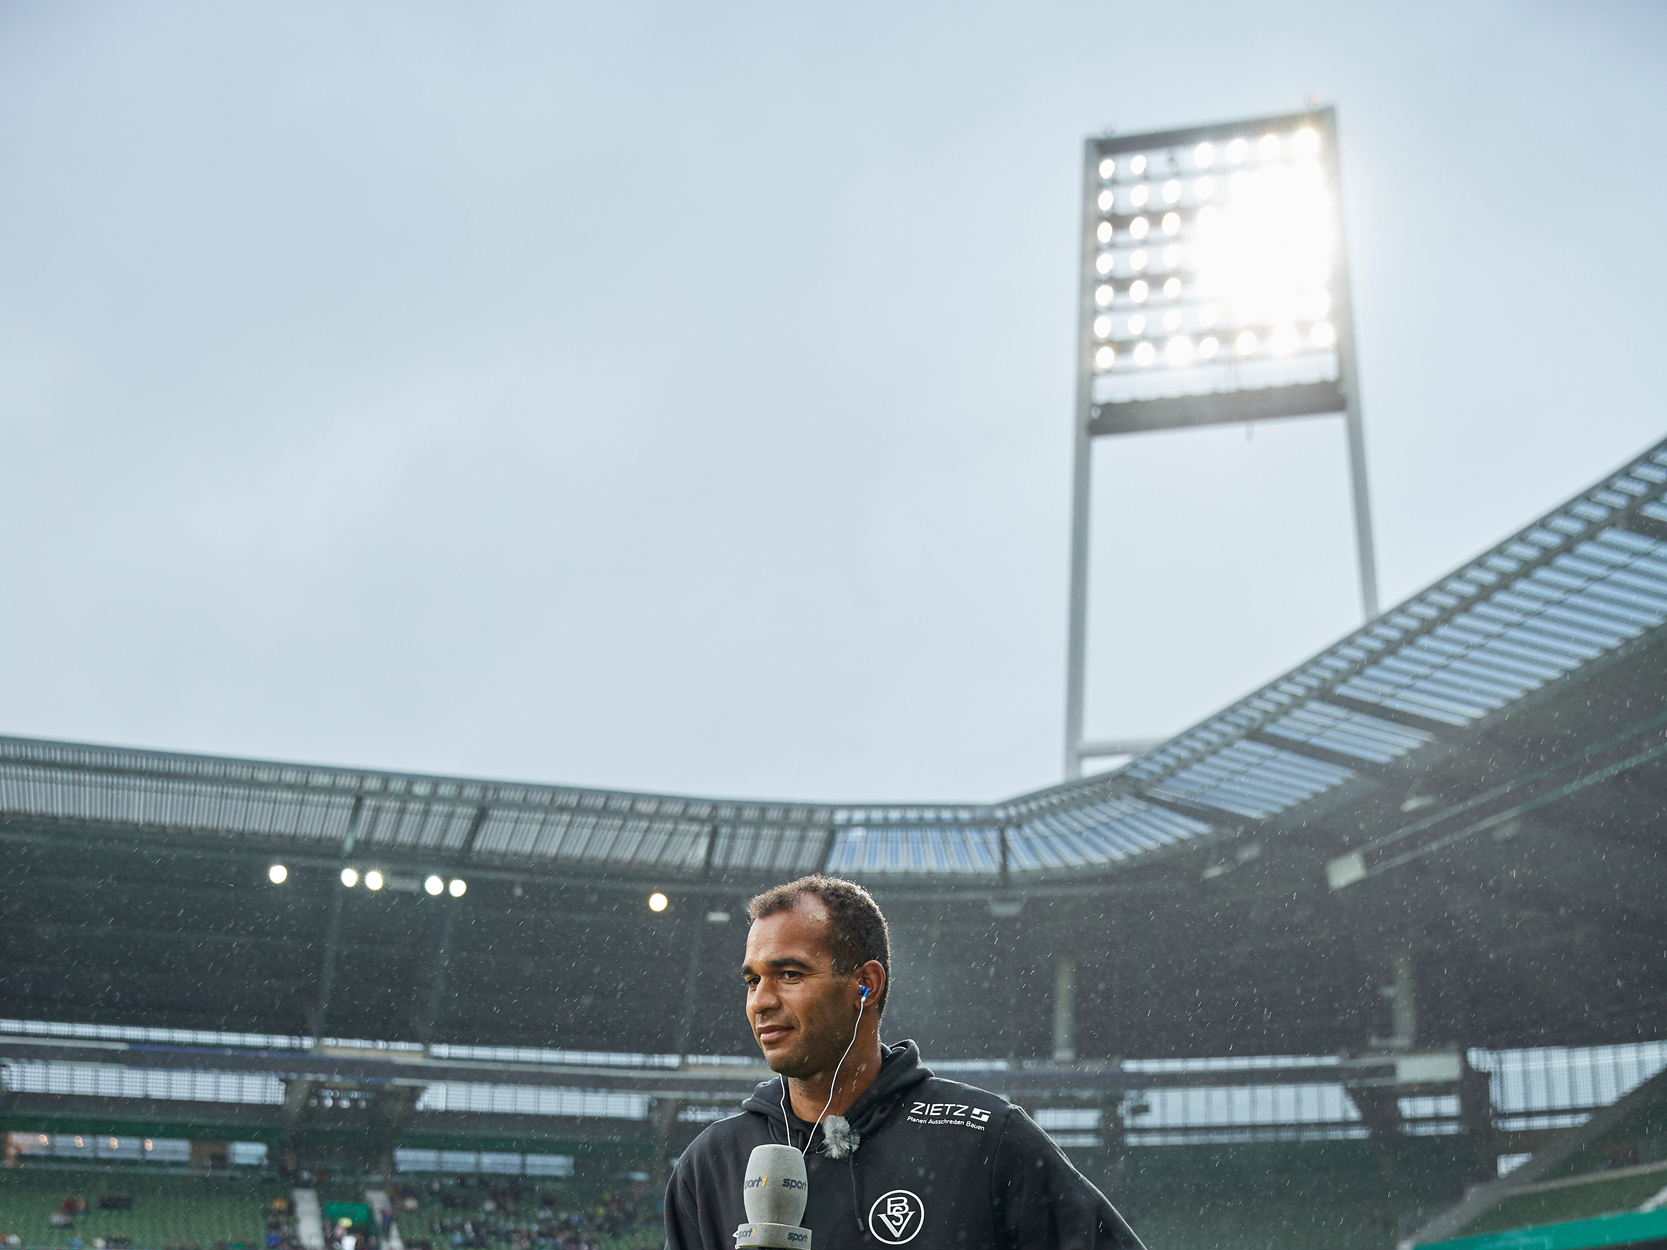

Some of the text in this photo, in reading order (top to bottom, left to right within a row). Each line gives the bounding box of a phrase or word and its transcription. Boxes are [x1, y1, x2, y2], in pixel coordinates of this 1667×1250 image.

[909, 1101, 969, 1117] ZIETZ
[928, 1118, 965, 1126] Ausschreiben
[965, 1120, 986, 1131] Bauen
[744, 1175, 768, 1191] port1
[738, 1226, 757, 1240] port1
